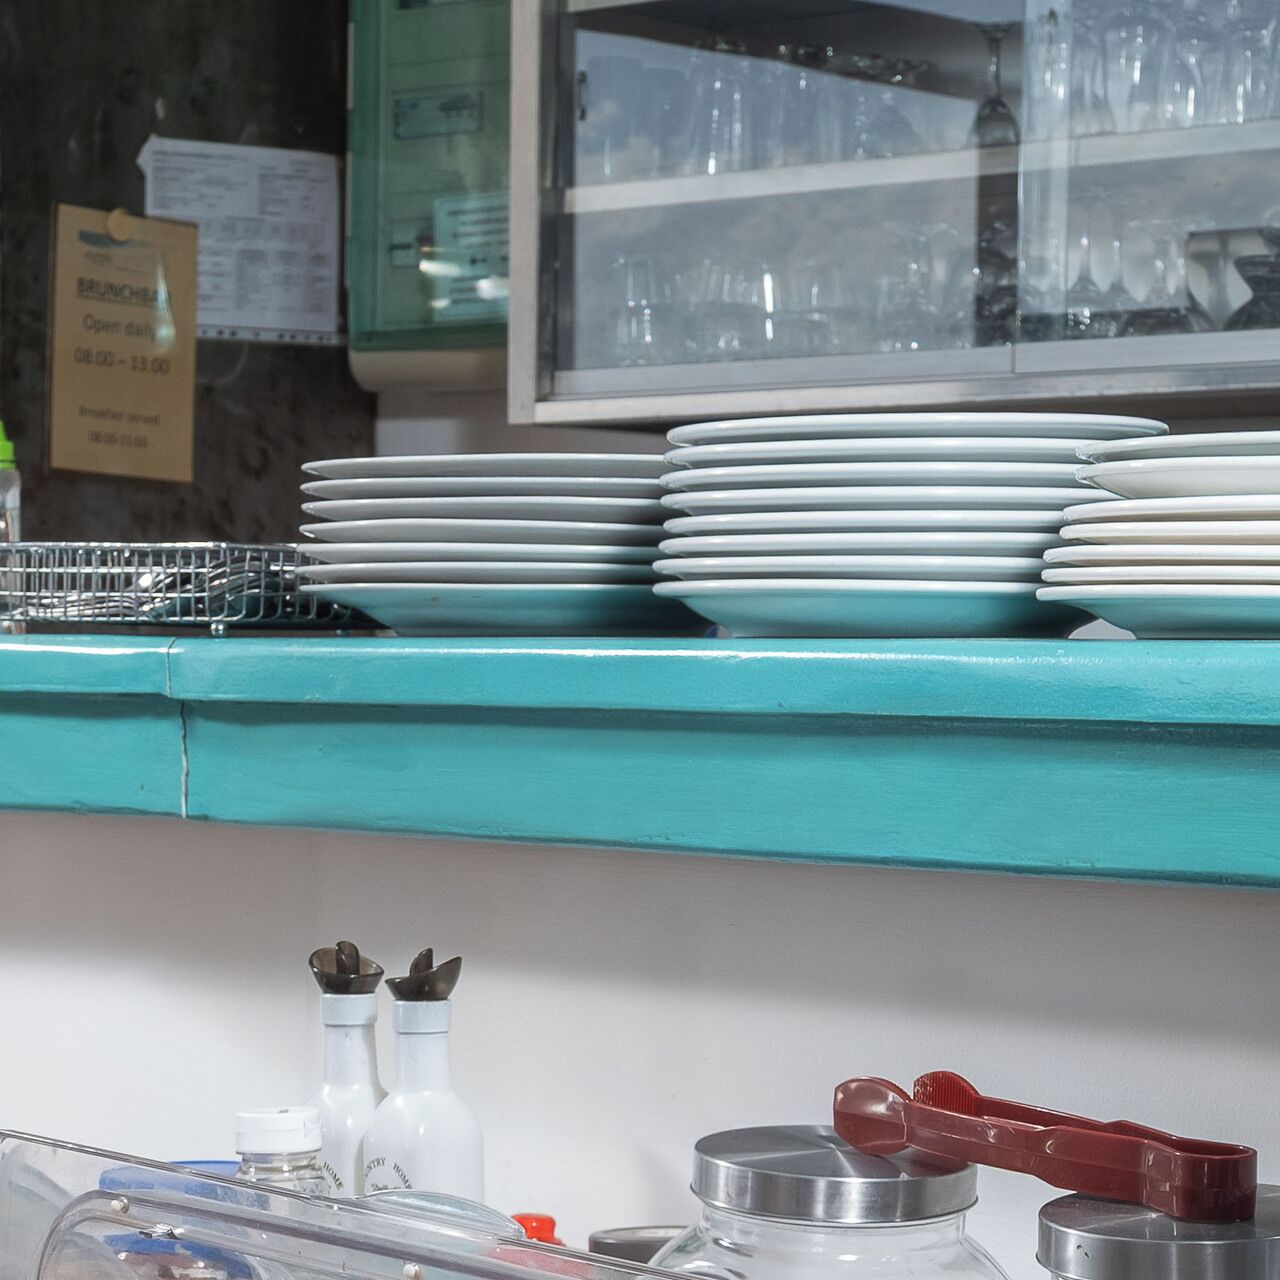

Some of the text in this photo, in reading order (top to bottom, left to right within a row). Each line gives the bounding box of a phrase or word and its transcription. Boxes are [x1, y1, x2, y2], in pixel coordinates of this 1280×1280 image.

[83, 313, 122, 334] Open
[322, 1161, 345, 1191] HOME
[392, 1162, 414, 1190] HOME
